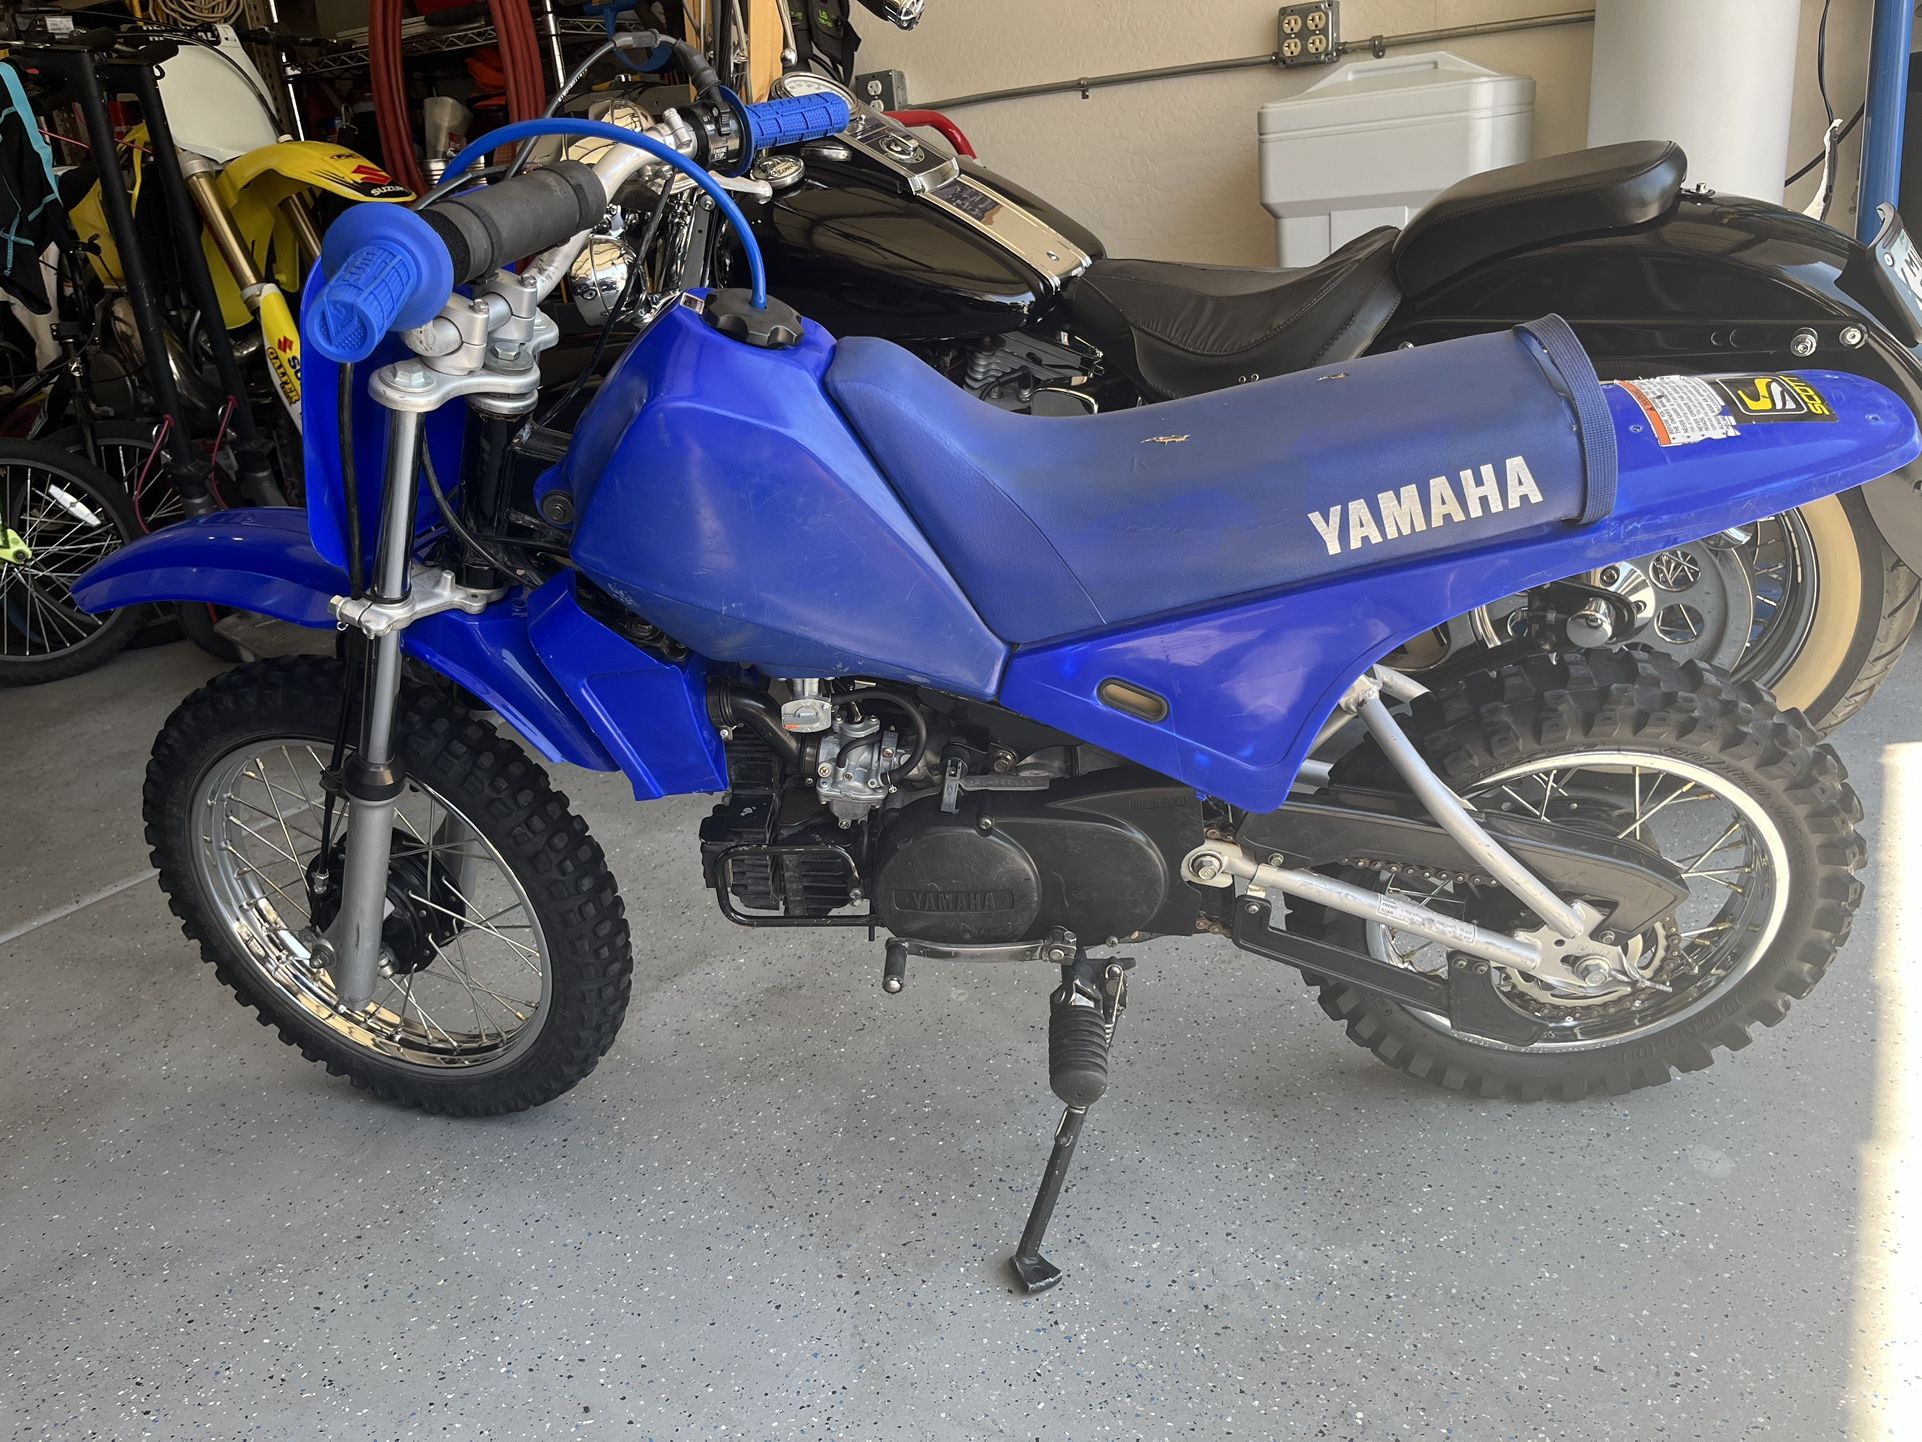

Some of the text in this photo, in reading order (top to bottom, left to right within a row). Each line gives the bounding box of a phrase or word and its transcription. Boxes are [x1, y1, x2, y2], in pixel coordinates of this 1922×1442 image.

[1778, 375, 1830, 415] SCOTT
[1307, 455, 1543, 556] YAMAHA
[911, 891, 996, 912] YAMAHA
